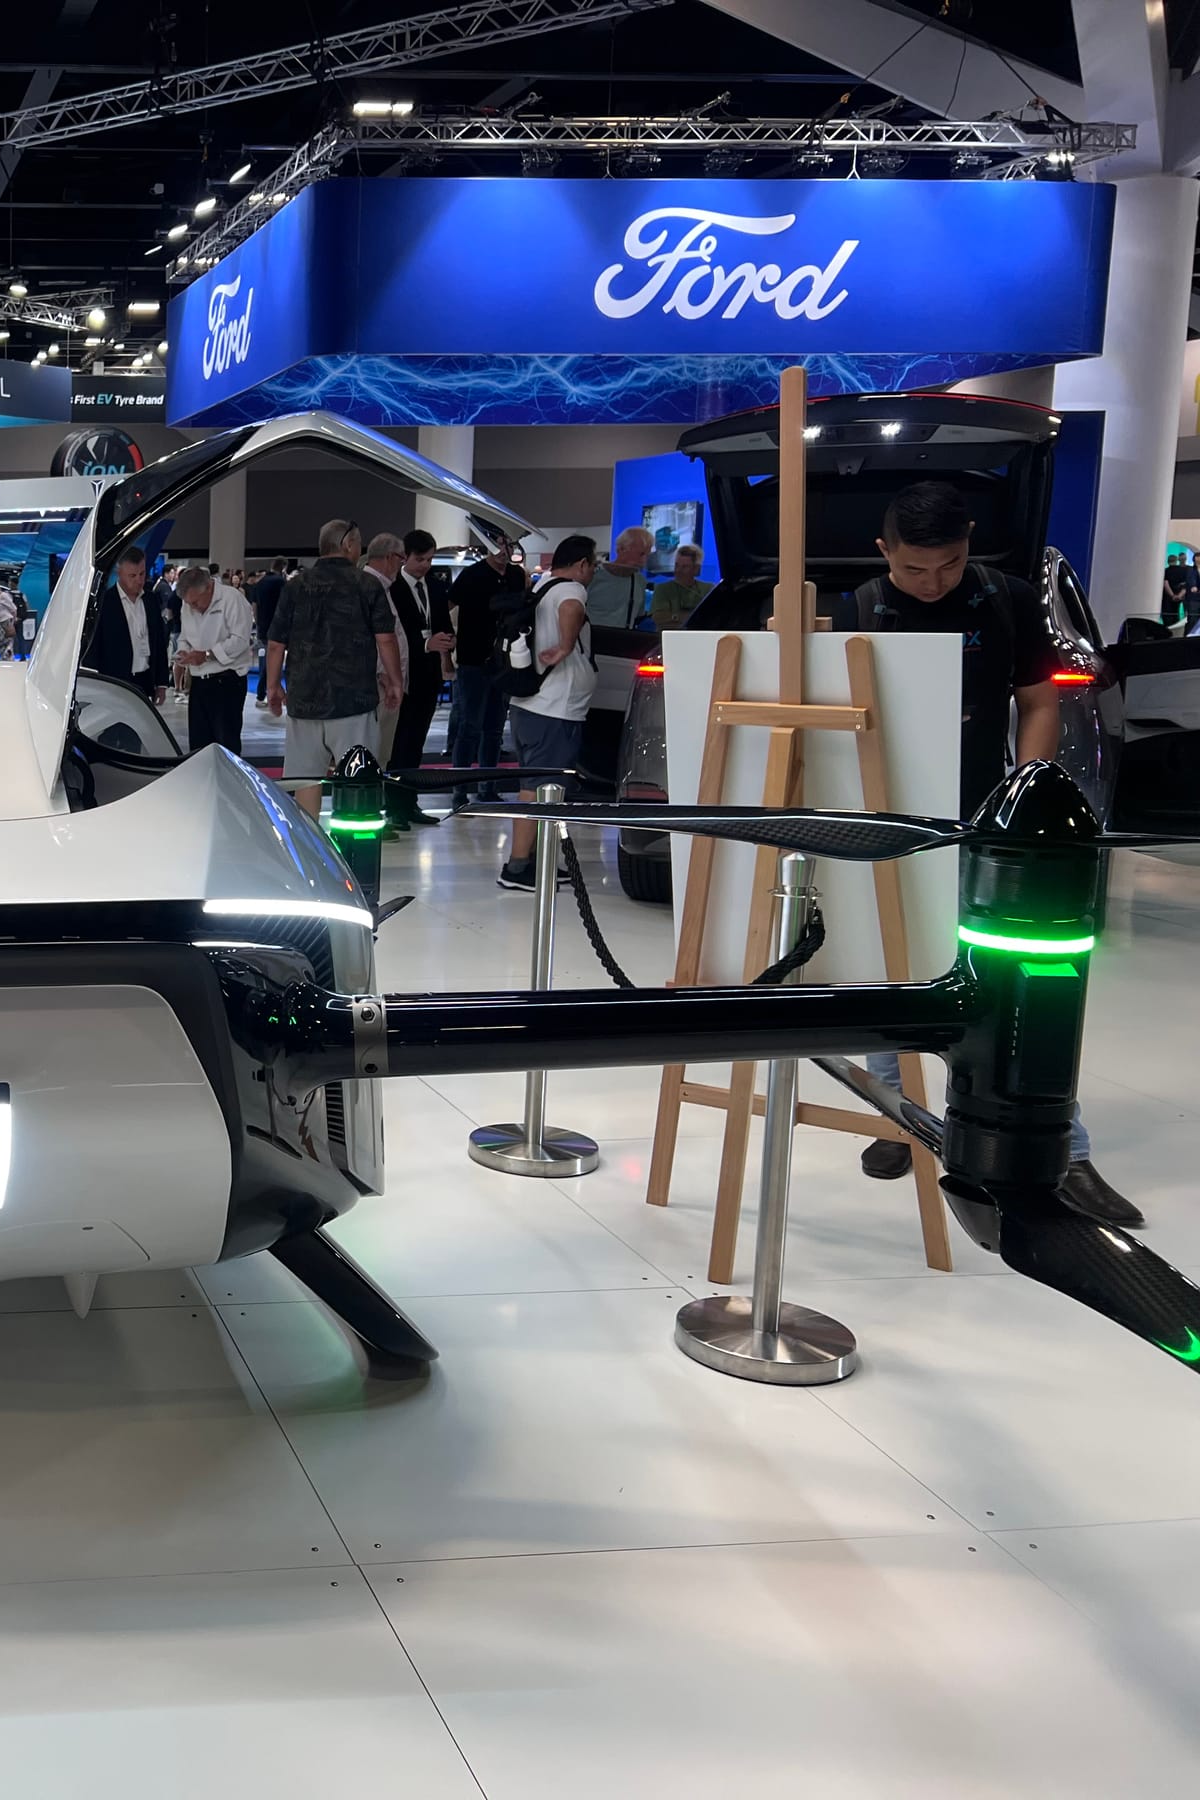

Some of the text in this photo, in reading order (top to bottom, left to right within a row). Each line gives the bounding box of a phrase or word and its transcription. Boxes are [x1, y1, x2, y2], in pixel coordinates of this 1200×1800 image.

[594, 207, 860, 320] Ford
[203, 274, 254, 380] Ford
[74, 395, 95, 405] First
[97, 394, 113, 405] EV
[115, 395, 135, 407] Tyre
[136, 395, 165, 405] Brand
